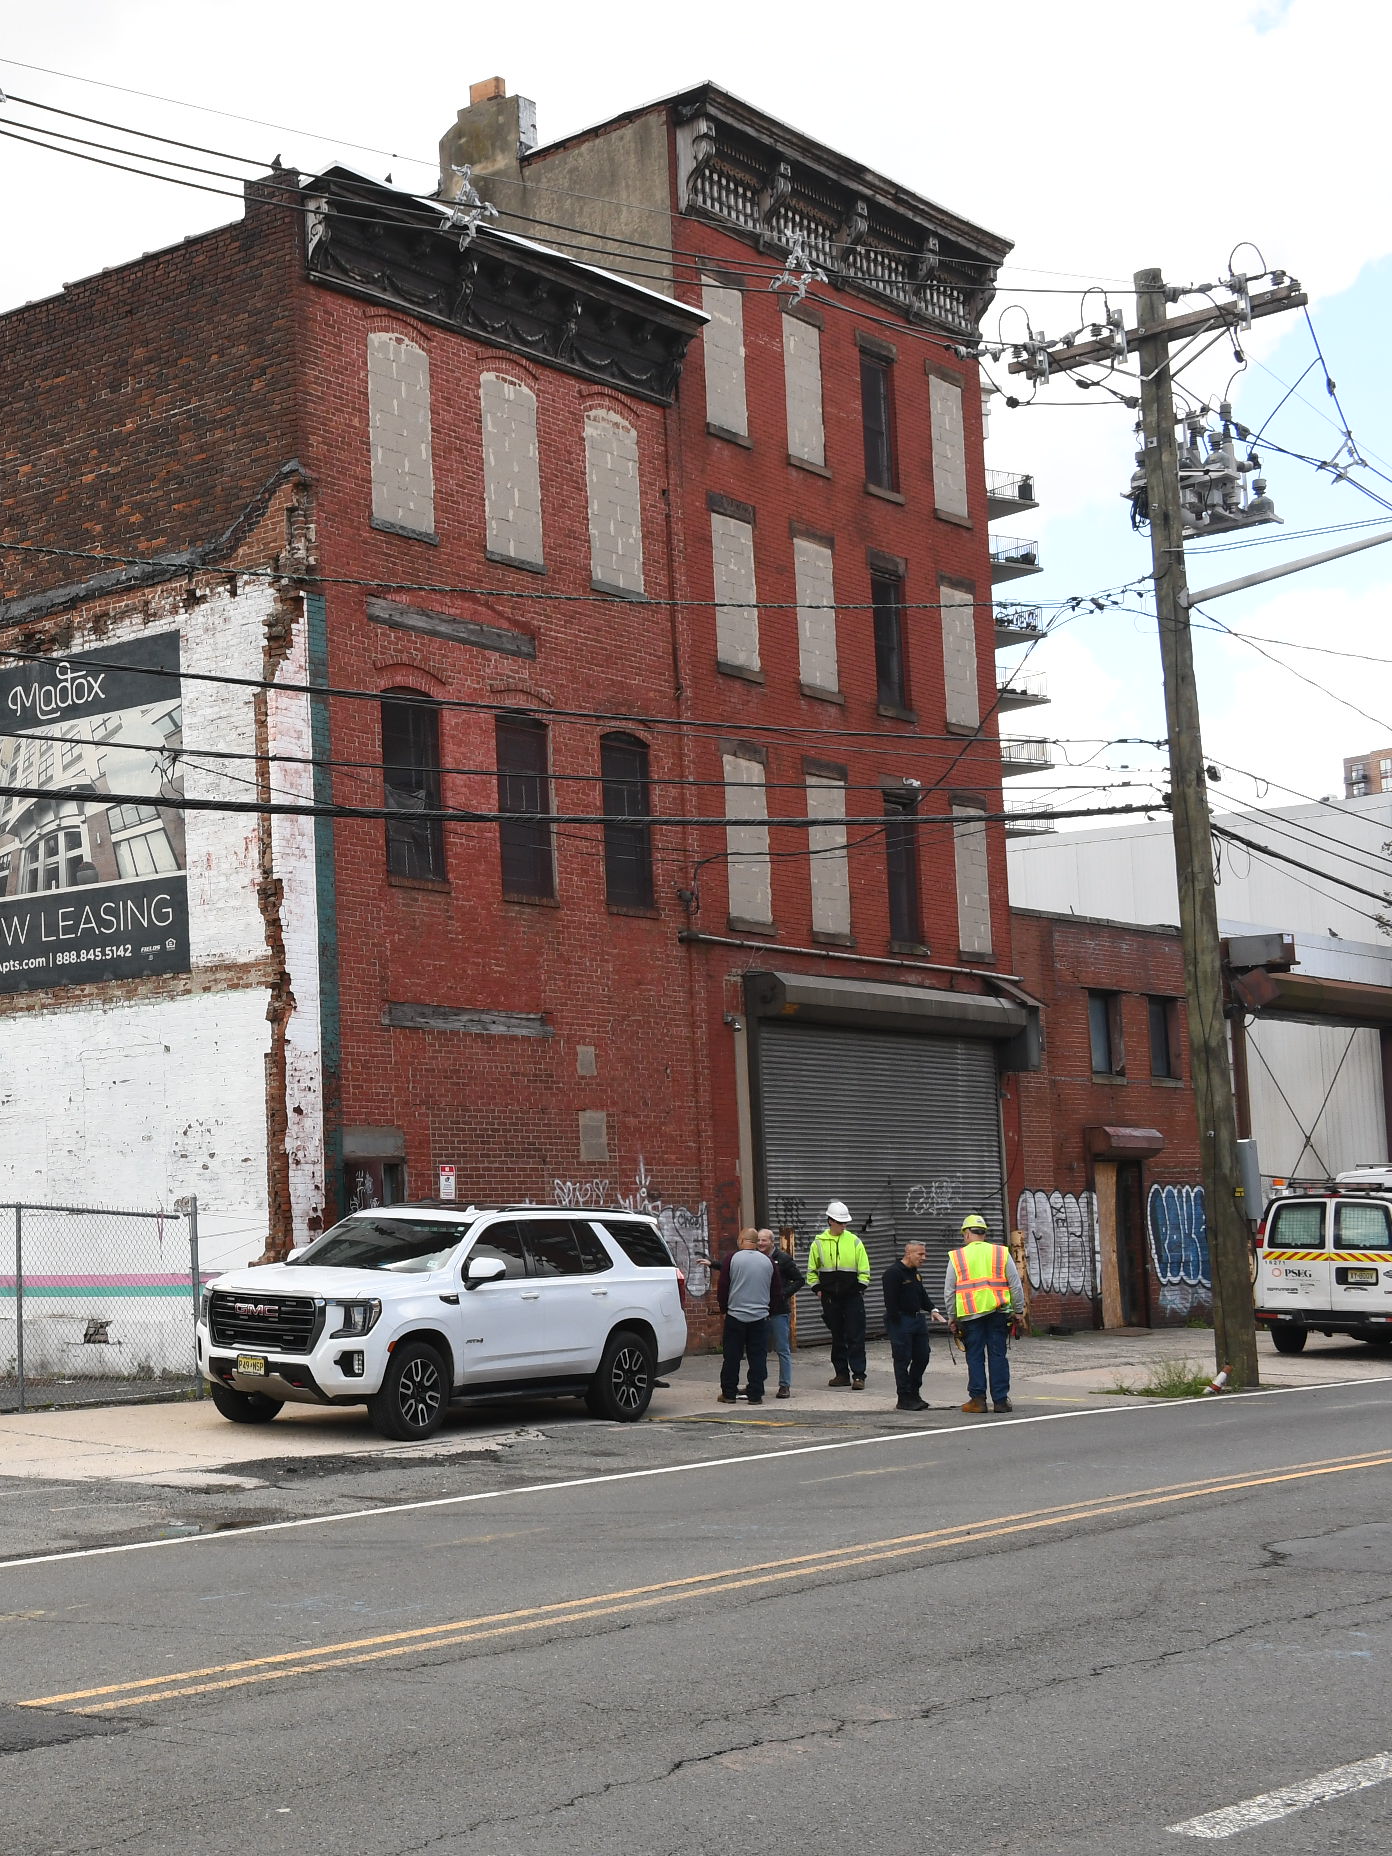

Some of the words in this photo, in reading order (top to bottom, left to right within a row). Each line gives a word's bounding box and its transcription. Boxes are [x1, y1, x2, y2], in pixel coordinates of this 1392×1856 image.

[8, 661, 105, 720] Madox
[41, 894, 174, 942] LEASING
[55, 944, 133, 965] 888.845.5142
[1284, 1268, 1312, 1278] PSEG
[234, 1302, 279, 1318] GMC
